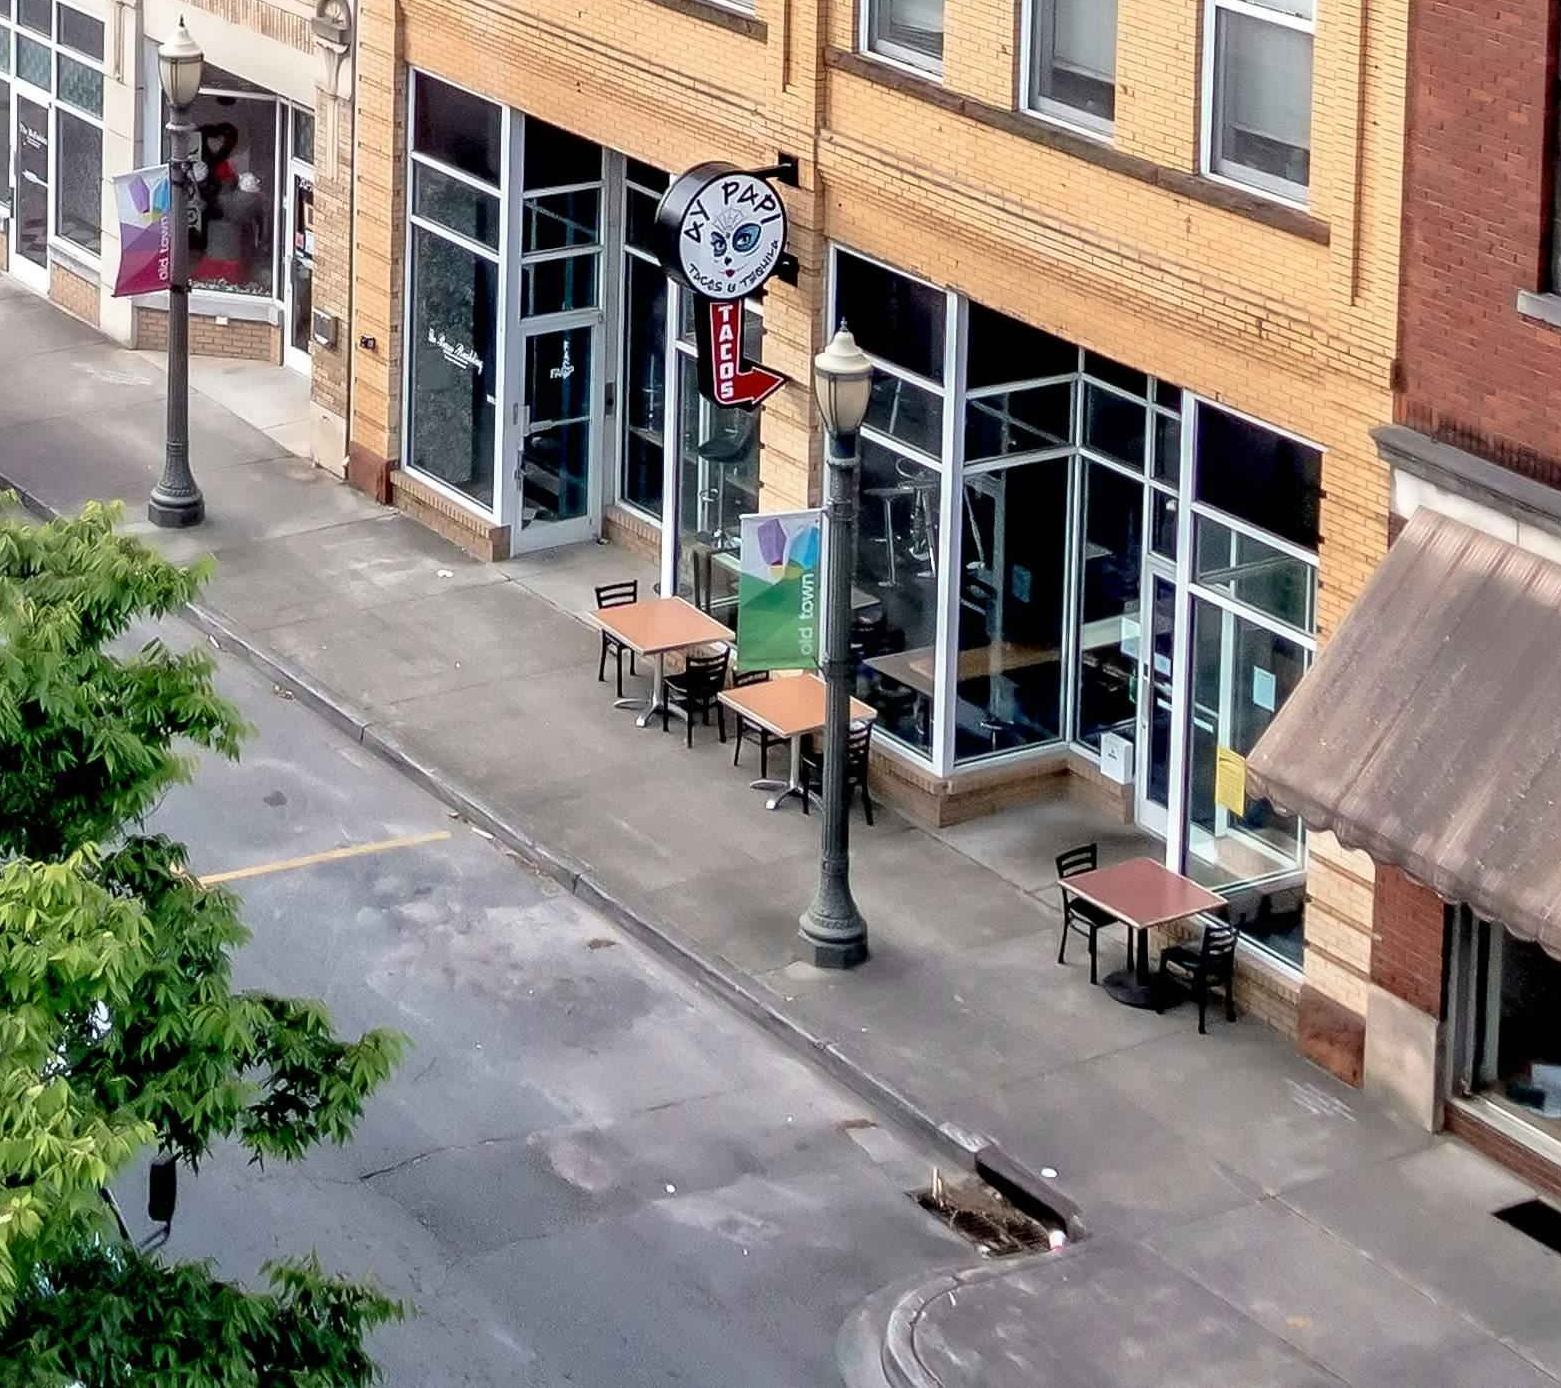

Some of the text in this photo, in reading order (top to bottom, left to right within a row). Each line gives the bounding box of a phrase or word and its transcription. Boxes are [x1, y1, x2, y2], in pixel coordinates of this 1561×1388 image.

[158, 214, 170, 281] old town
[683, 181, 782, 244] AY PAPI
[718, 304, 734, 400] TACOS
[798, 572, 815, 656] old town
